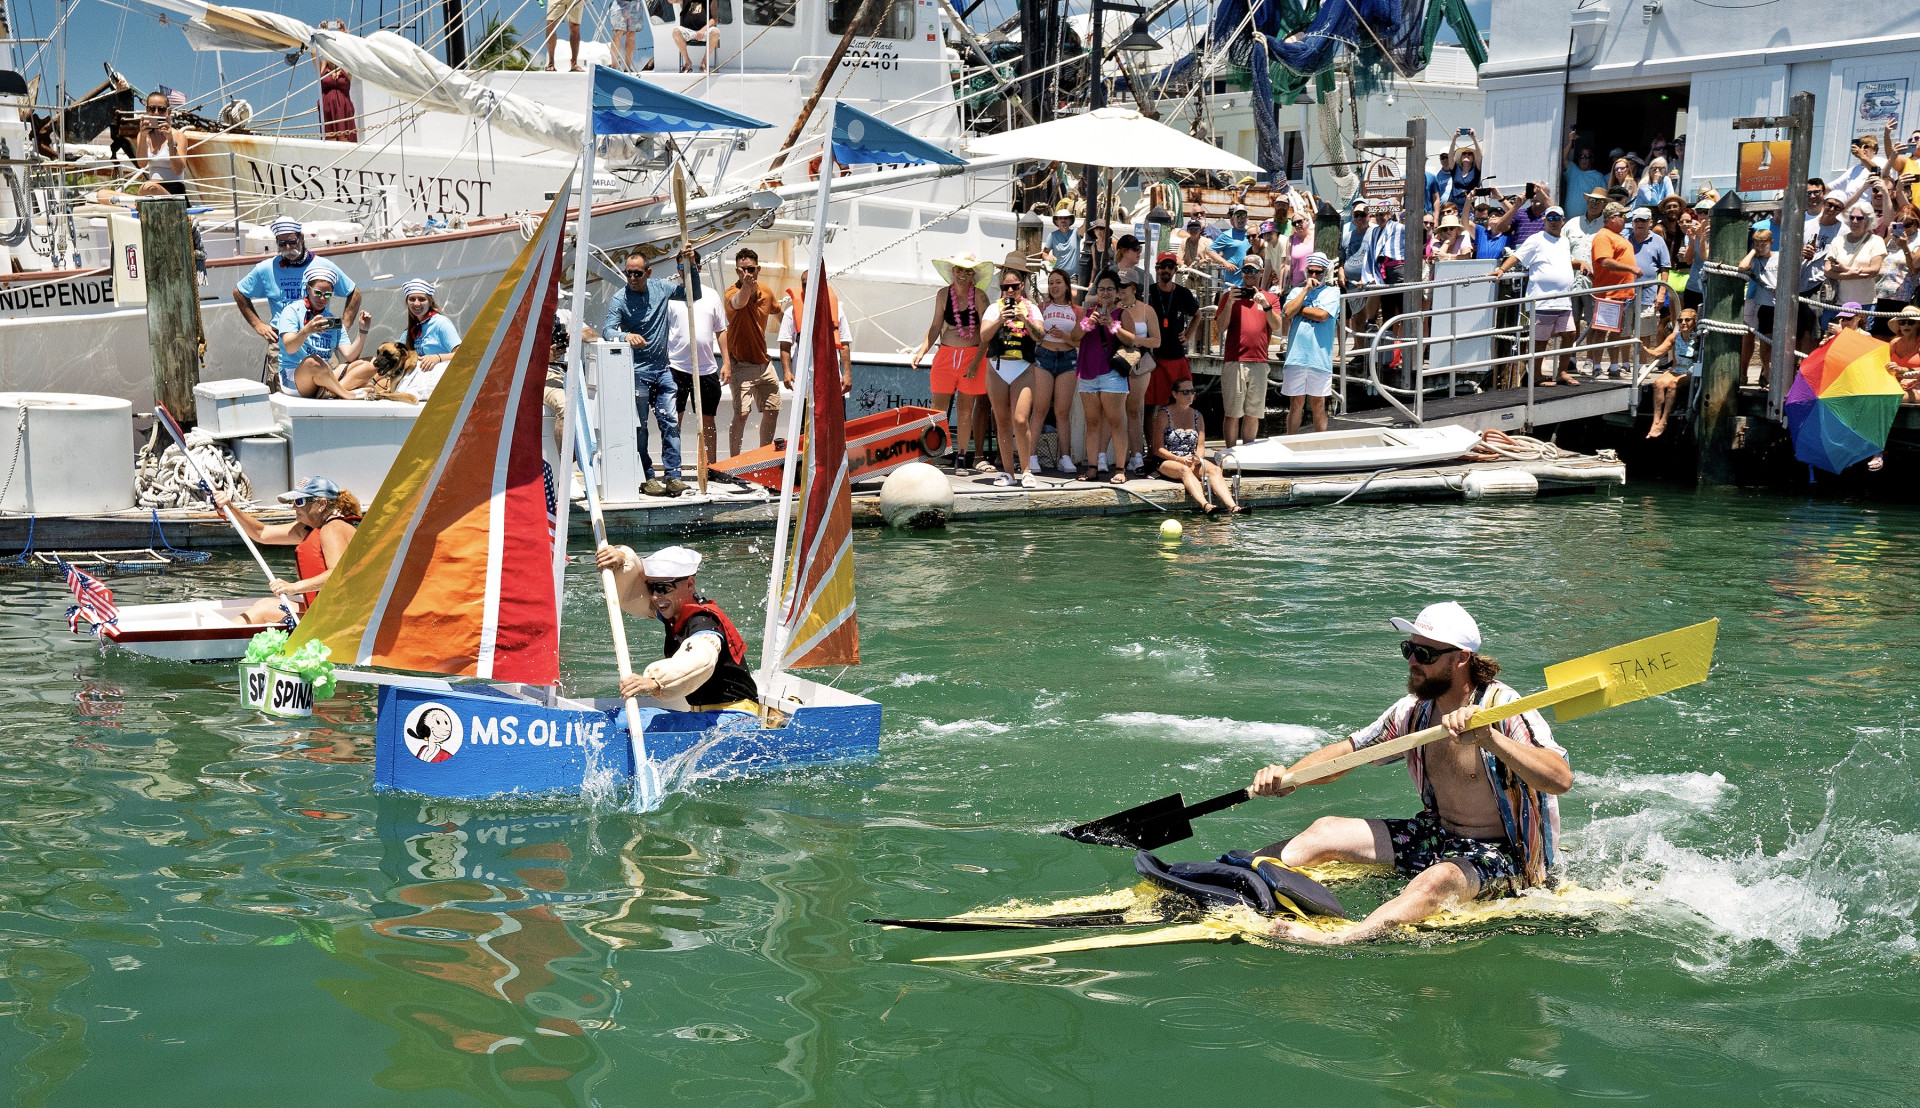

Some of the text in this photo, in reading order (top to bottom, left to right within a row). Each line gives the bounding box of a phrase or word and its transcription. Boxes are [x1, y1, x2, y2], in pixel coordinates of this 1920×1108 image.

[870, 40, 893, 50] Mark
[247, 160, 325, 201] MISS
[408, 174, 492, 217] WEST
[129, 251, 137, 278] FIRE
[1610, 652, 1678, 684] TAKE
